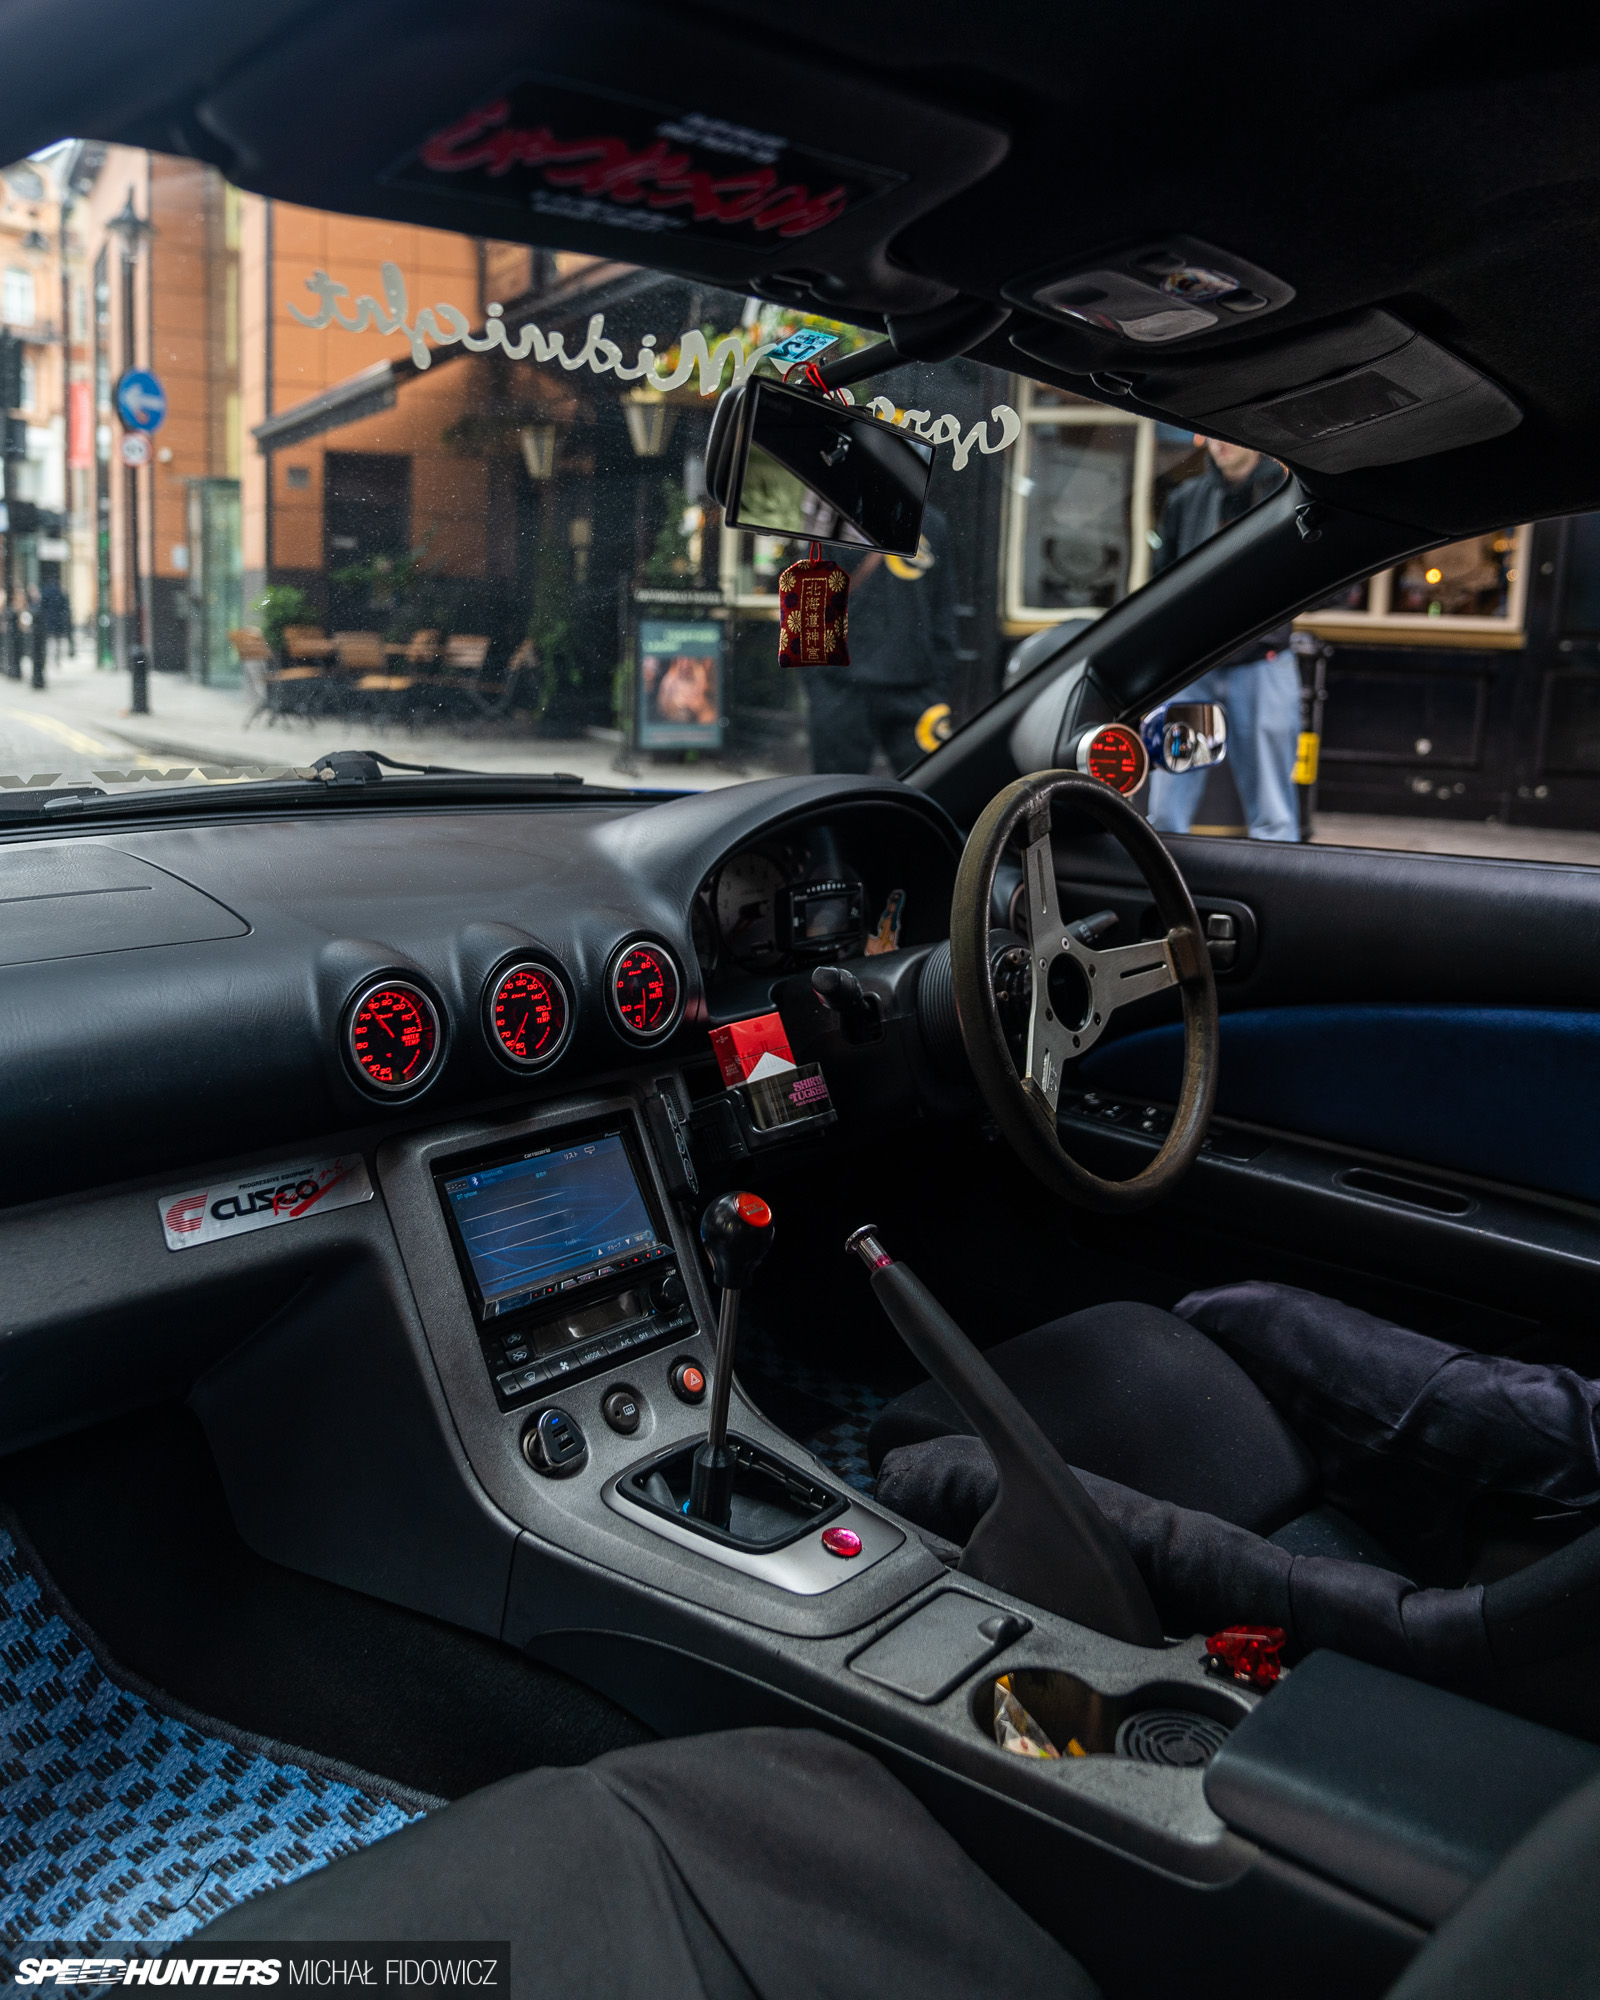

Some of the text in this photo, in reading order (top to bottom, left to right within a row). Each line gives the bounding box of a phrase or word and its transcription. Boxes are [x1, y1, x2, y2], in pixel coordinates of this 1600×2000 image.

[392, 1003, 406, 1011] 100
[360, 1013, 372, 1021] 70
[403, 1027, 417, 1035] 120
[401, 1033, 420, 1042] WATER
[404, 1039, 420, 1047] TEMP
[379, 1067, 392, 1075] 20
[239, 1167, 315, 1190] PROGRESSIVE EQUIPMENT
[211, 1179, 320, 1221] CUSCO
[668, 1318, 683, 1328] AUTO
[638, 1331, 649, 1340] OFF
[620, 1338, 632, 1347] A/C
[584, 1350, 602, 1361] MODE
